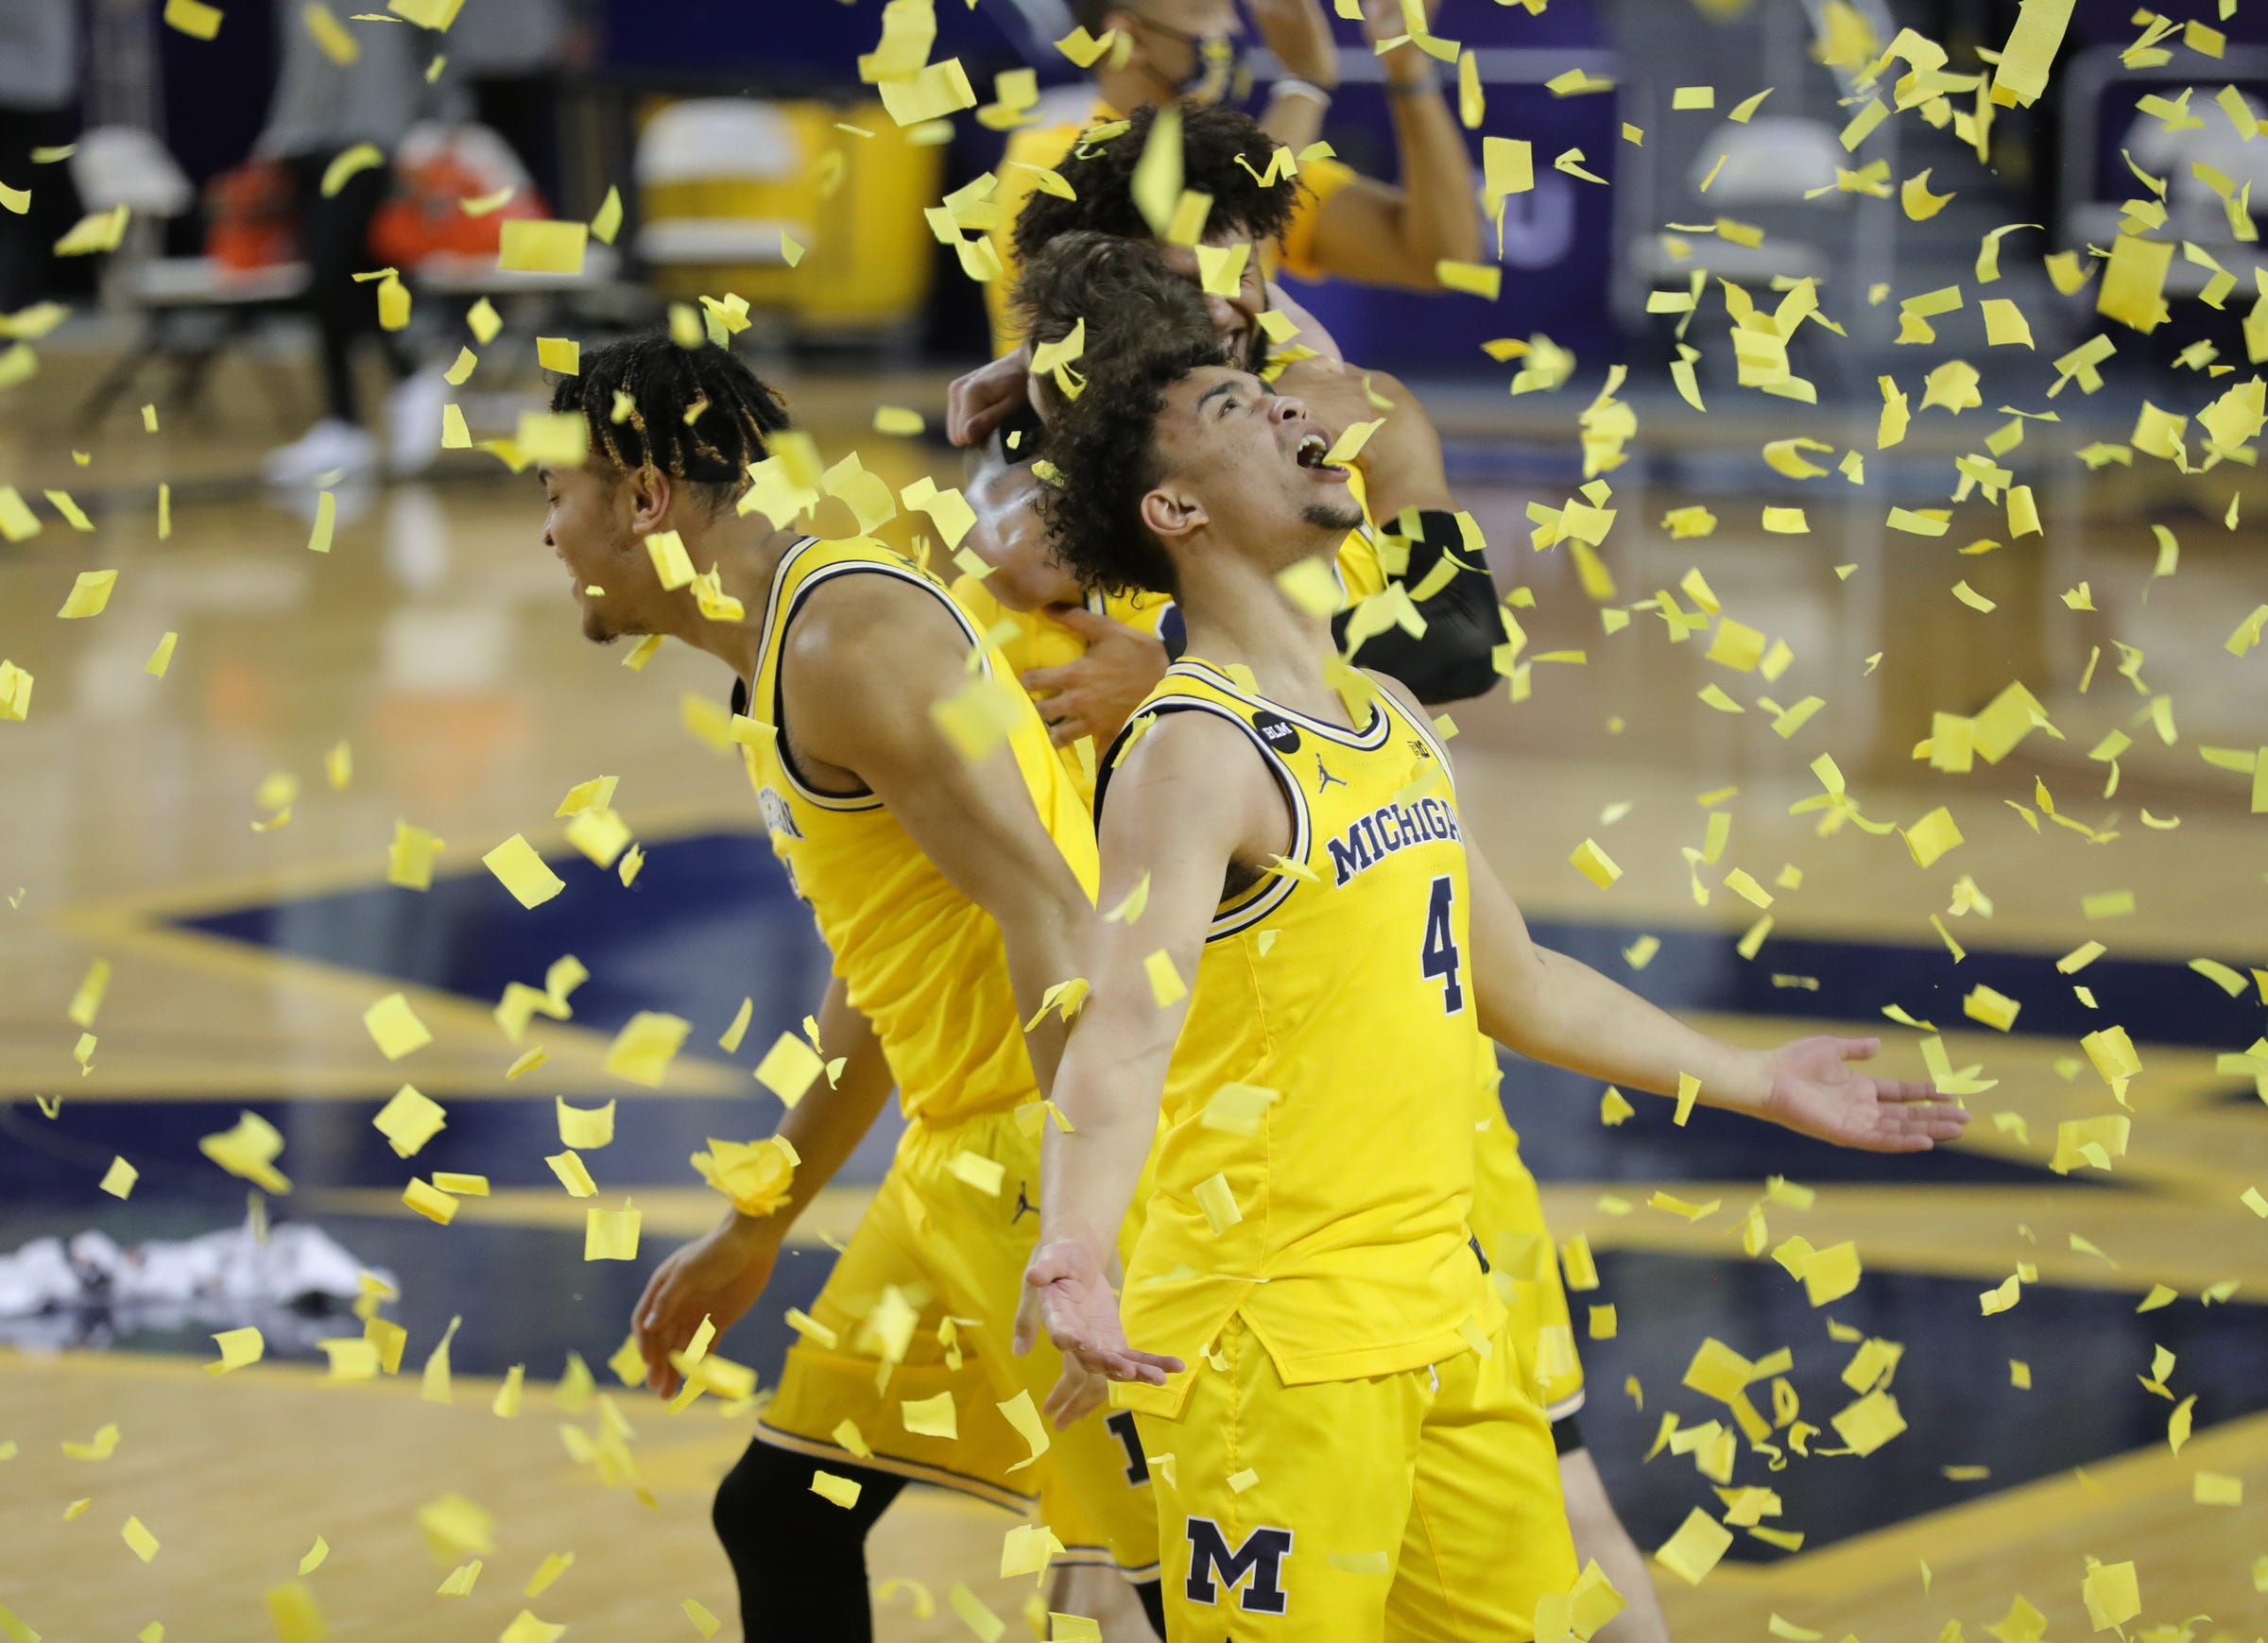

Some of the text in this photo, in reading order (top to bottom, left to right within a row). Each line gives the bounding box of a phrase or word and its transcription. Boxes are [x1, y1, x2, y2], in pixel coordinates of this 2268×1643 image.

[1263, 722, 1293, 740] BLM
[1422, 874, 1465, 1017] 4
[1185, 1515, 1294, 1616] M
